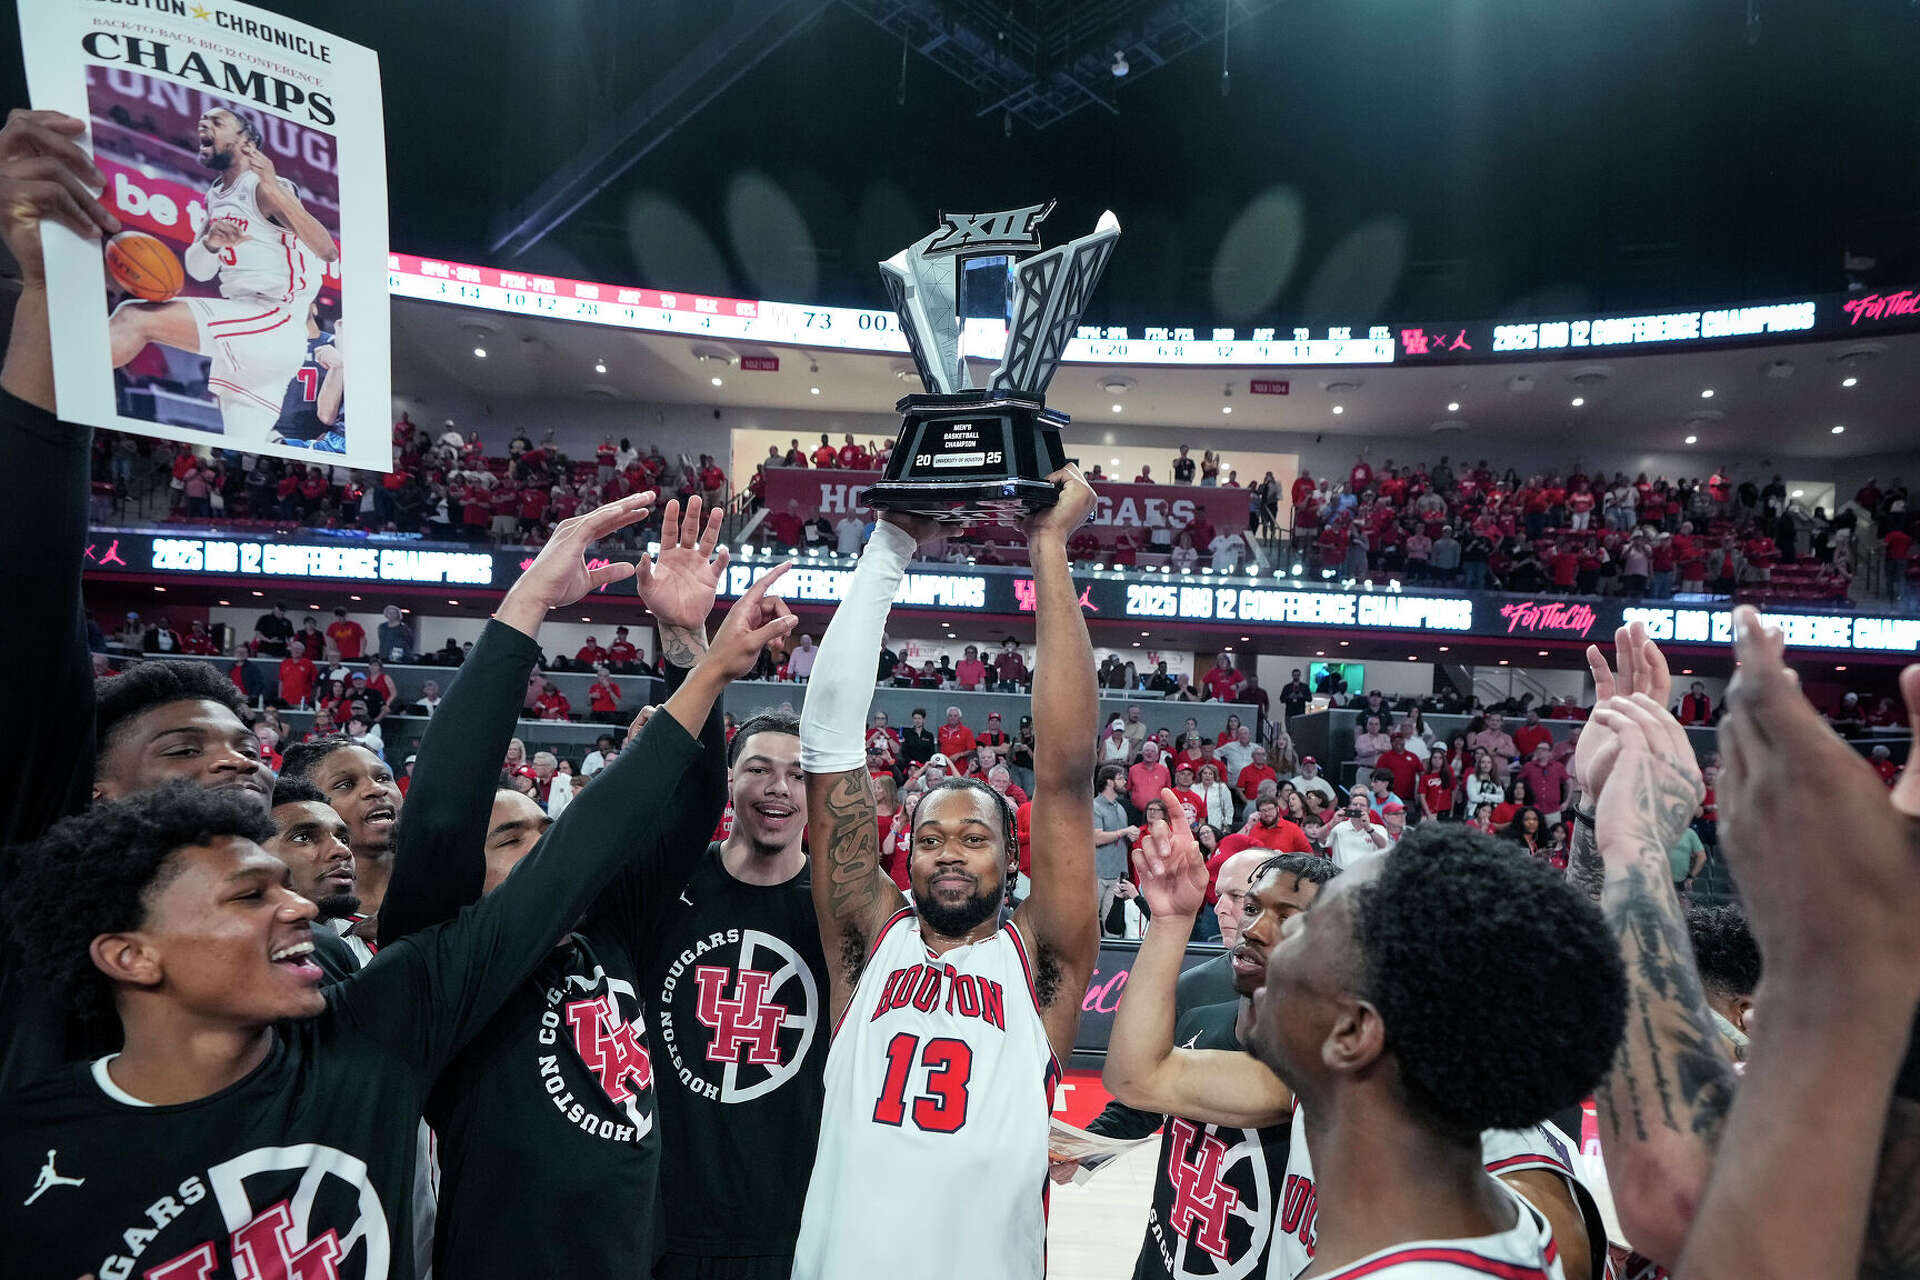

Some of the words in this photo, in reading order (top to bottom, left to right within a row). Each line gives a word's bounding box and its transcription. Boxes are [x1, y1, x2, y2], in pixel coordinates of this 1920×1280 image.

[214, 9, 332, 64] CHRONICLE
[80, 31, 337, 127] CHAMPS
[238, 50, 324, 88] CONFERENCE
[114, 172, 179, 227] be
[802, 311, 833, 331] 73
[915, 454, 932, 467] 20
[985, 451, 1002, 466] 25
[943, 431, 980, 441] BASKETBALL
[944, 440, 977, 449] CHAMPION
[1125, 584, 1178, 617] 2025
[1215, 587, 1238, 620] 12
[661, 928, 740, 1004] COUGARS
[694, 964, 789, 1065] UH
[659, 1010, 721, 1101] HOUSTON
[871, 1031, 974, 1135] 13
[538, 1054, 635, 1142] HOUSTON
[1168, 1115, 1240, 1260] UH
